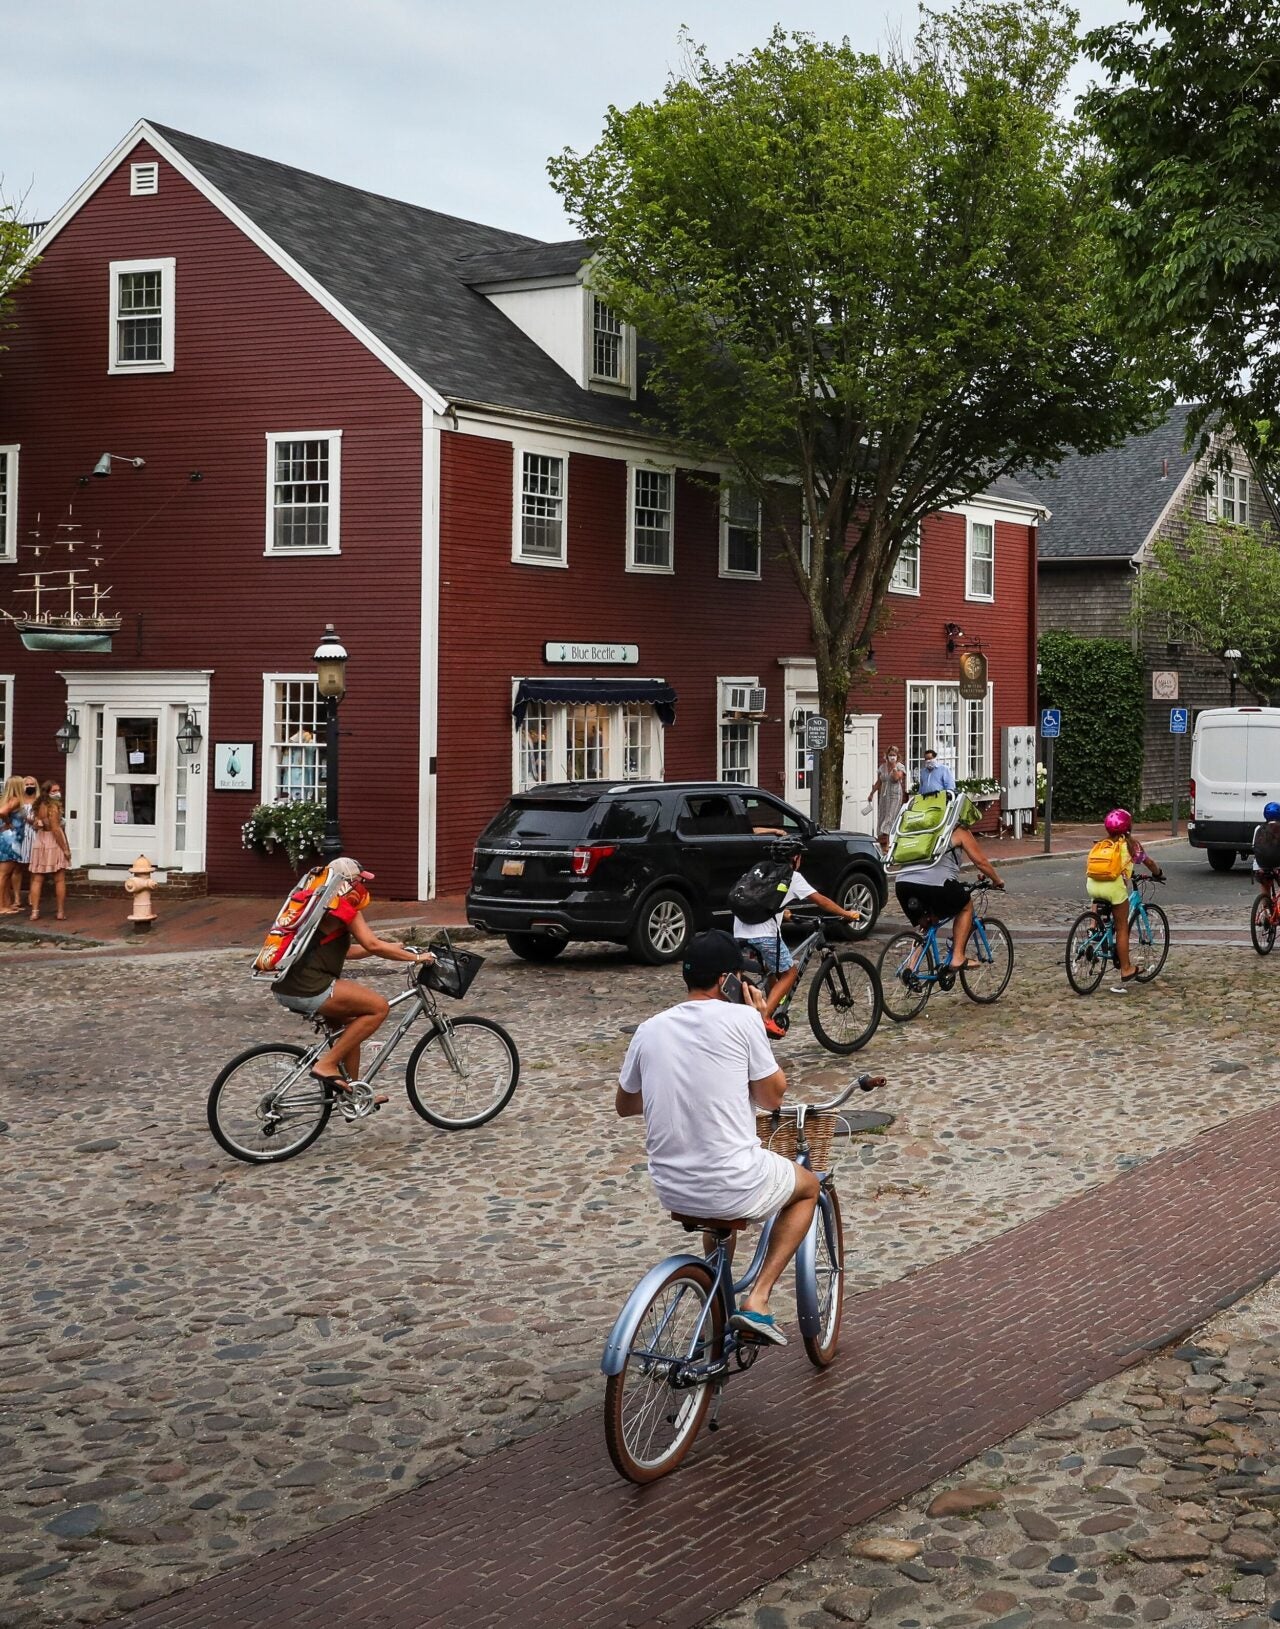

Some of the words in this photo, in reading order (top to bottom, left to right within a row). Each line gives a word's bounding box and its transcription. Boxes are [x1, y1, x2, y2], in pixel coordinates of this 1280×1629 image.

[571, 646, 589, 660] Blue
[591, 647, 616, 660] Beetle
[190, 763, 201, 774] 12
